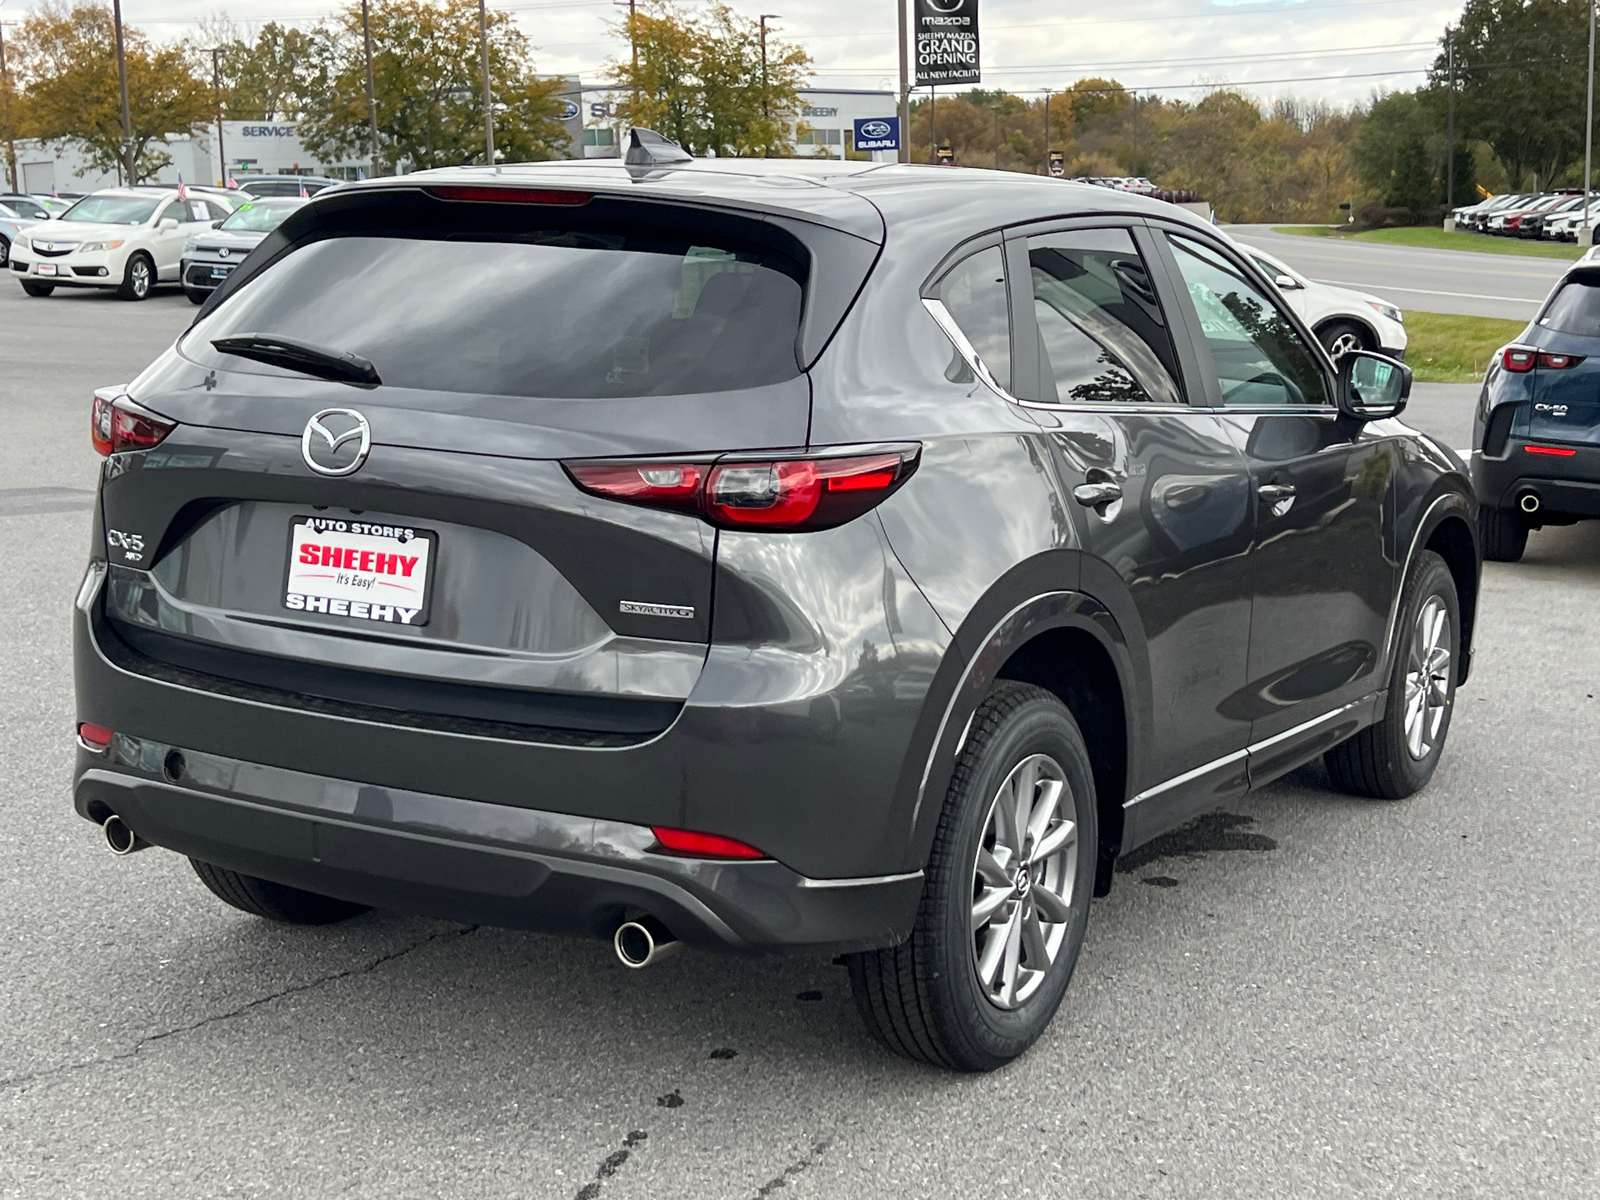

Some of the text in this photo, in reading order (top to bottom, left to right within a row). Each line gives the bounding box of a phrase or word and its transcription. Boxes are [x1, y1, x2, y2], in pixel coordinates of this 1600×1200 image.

[917, 32, 977, 41] SHEEHY MAZDA
[918, 39, 976, 54] GRAND
[919, 53, 976, 65] OPENING
[916, 69, 980, 79] ALL NEW FACILITY
[802, 107, 839, 117] SHEEHY
[242, 126, 296, 137] SERVICE
[857, 140, 896, 149] SUBARU
[305, 518, 415, 539] AUTO STORES
[107, 529, 145, 551] CX-5
[299, 543, 419, 577] SHEEHY
[336, 572, 376, 590] It's Easy!
[286, 593, 419, 624] SHEEHY
